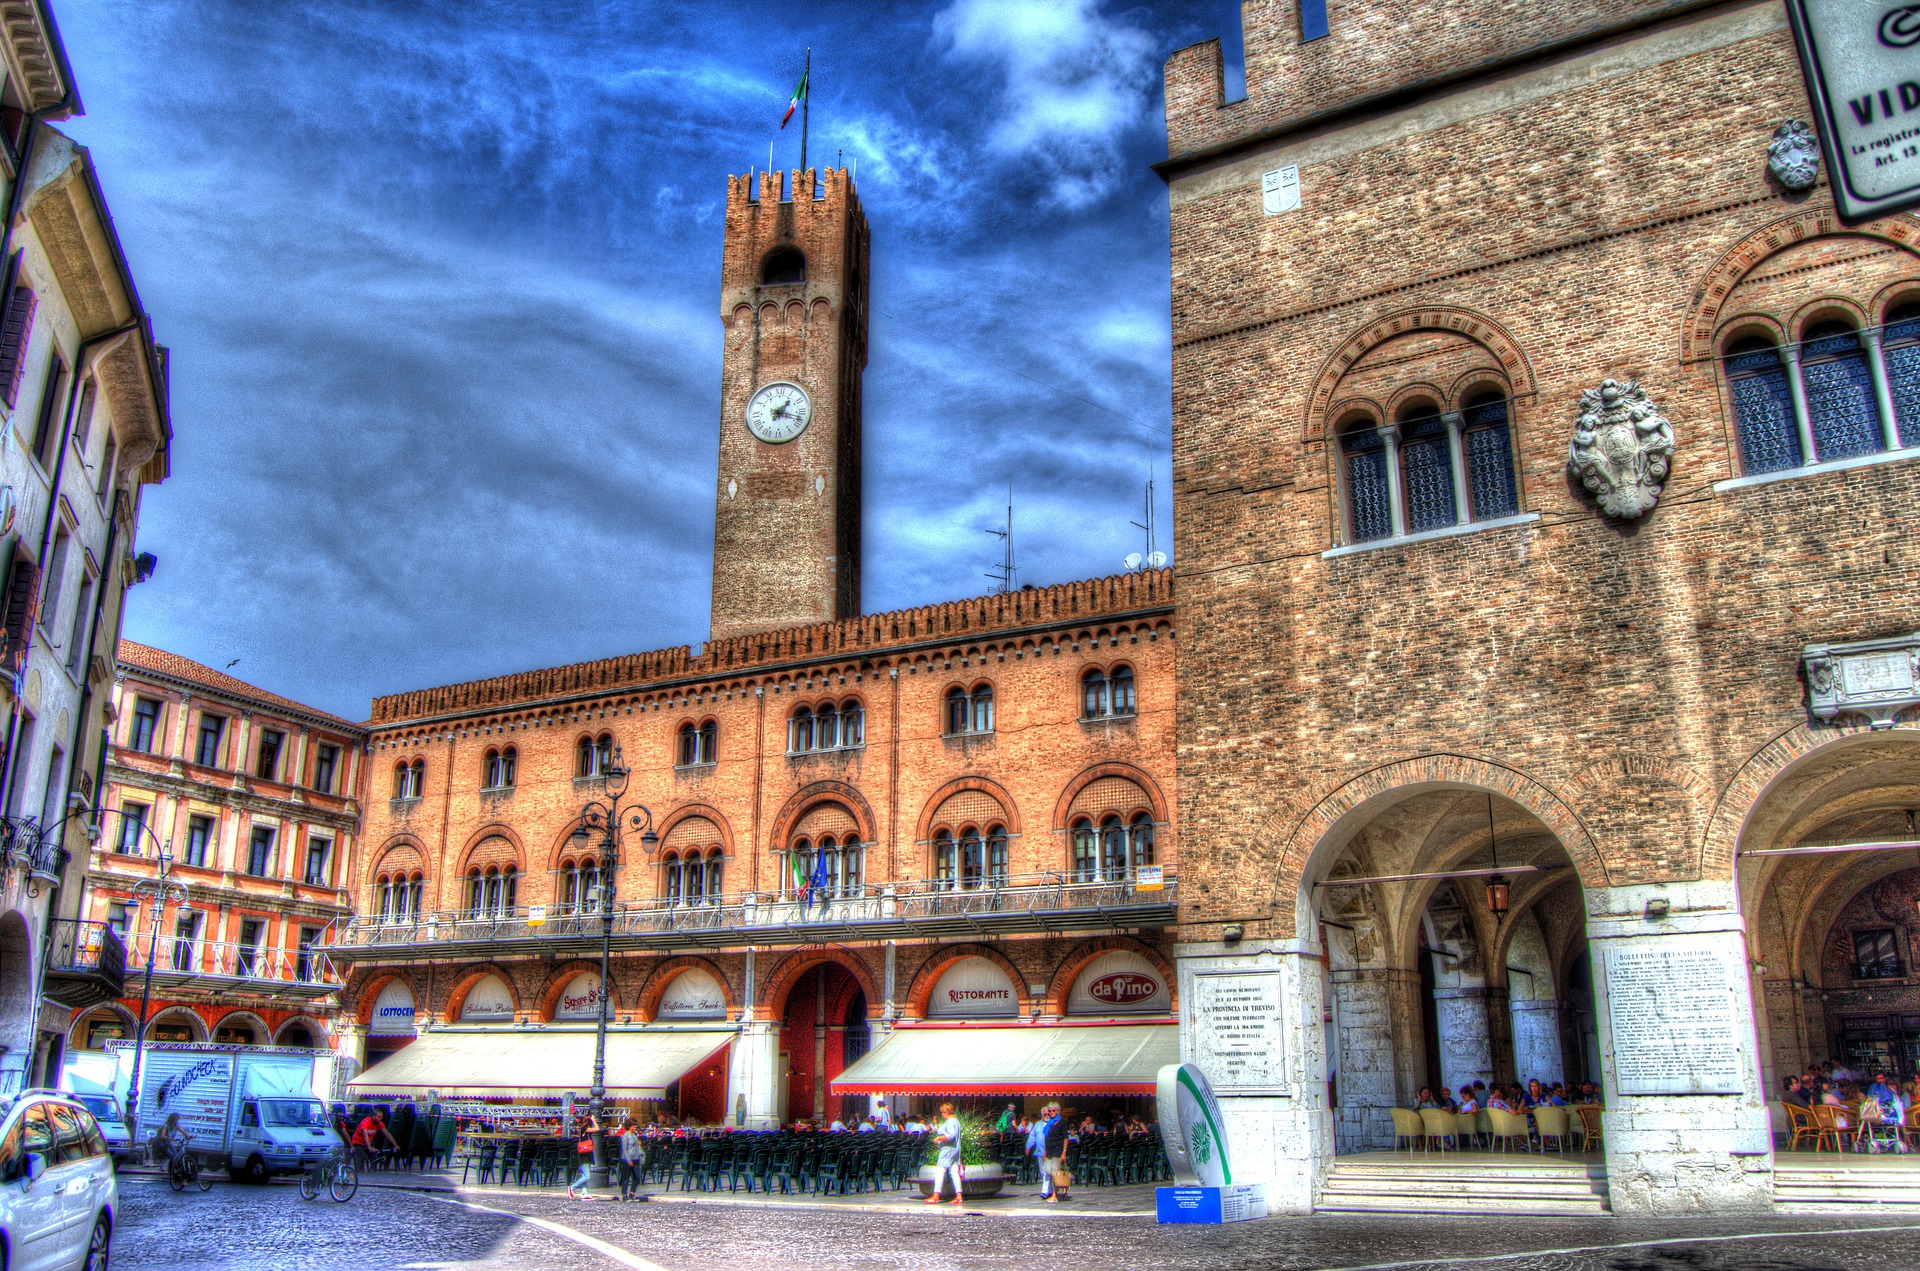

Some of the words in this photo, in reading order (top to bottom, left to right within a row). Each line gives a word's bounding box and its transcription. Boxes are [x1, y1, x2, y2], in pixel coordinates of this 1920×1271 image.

[1852, 144, 1866, 155] La
[1875, 153, 1898, 168] Art.
[155, 1032, 186, 1040] TEZENIS
